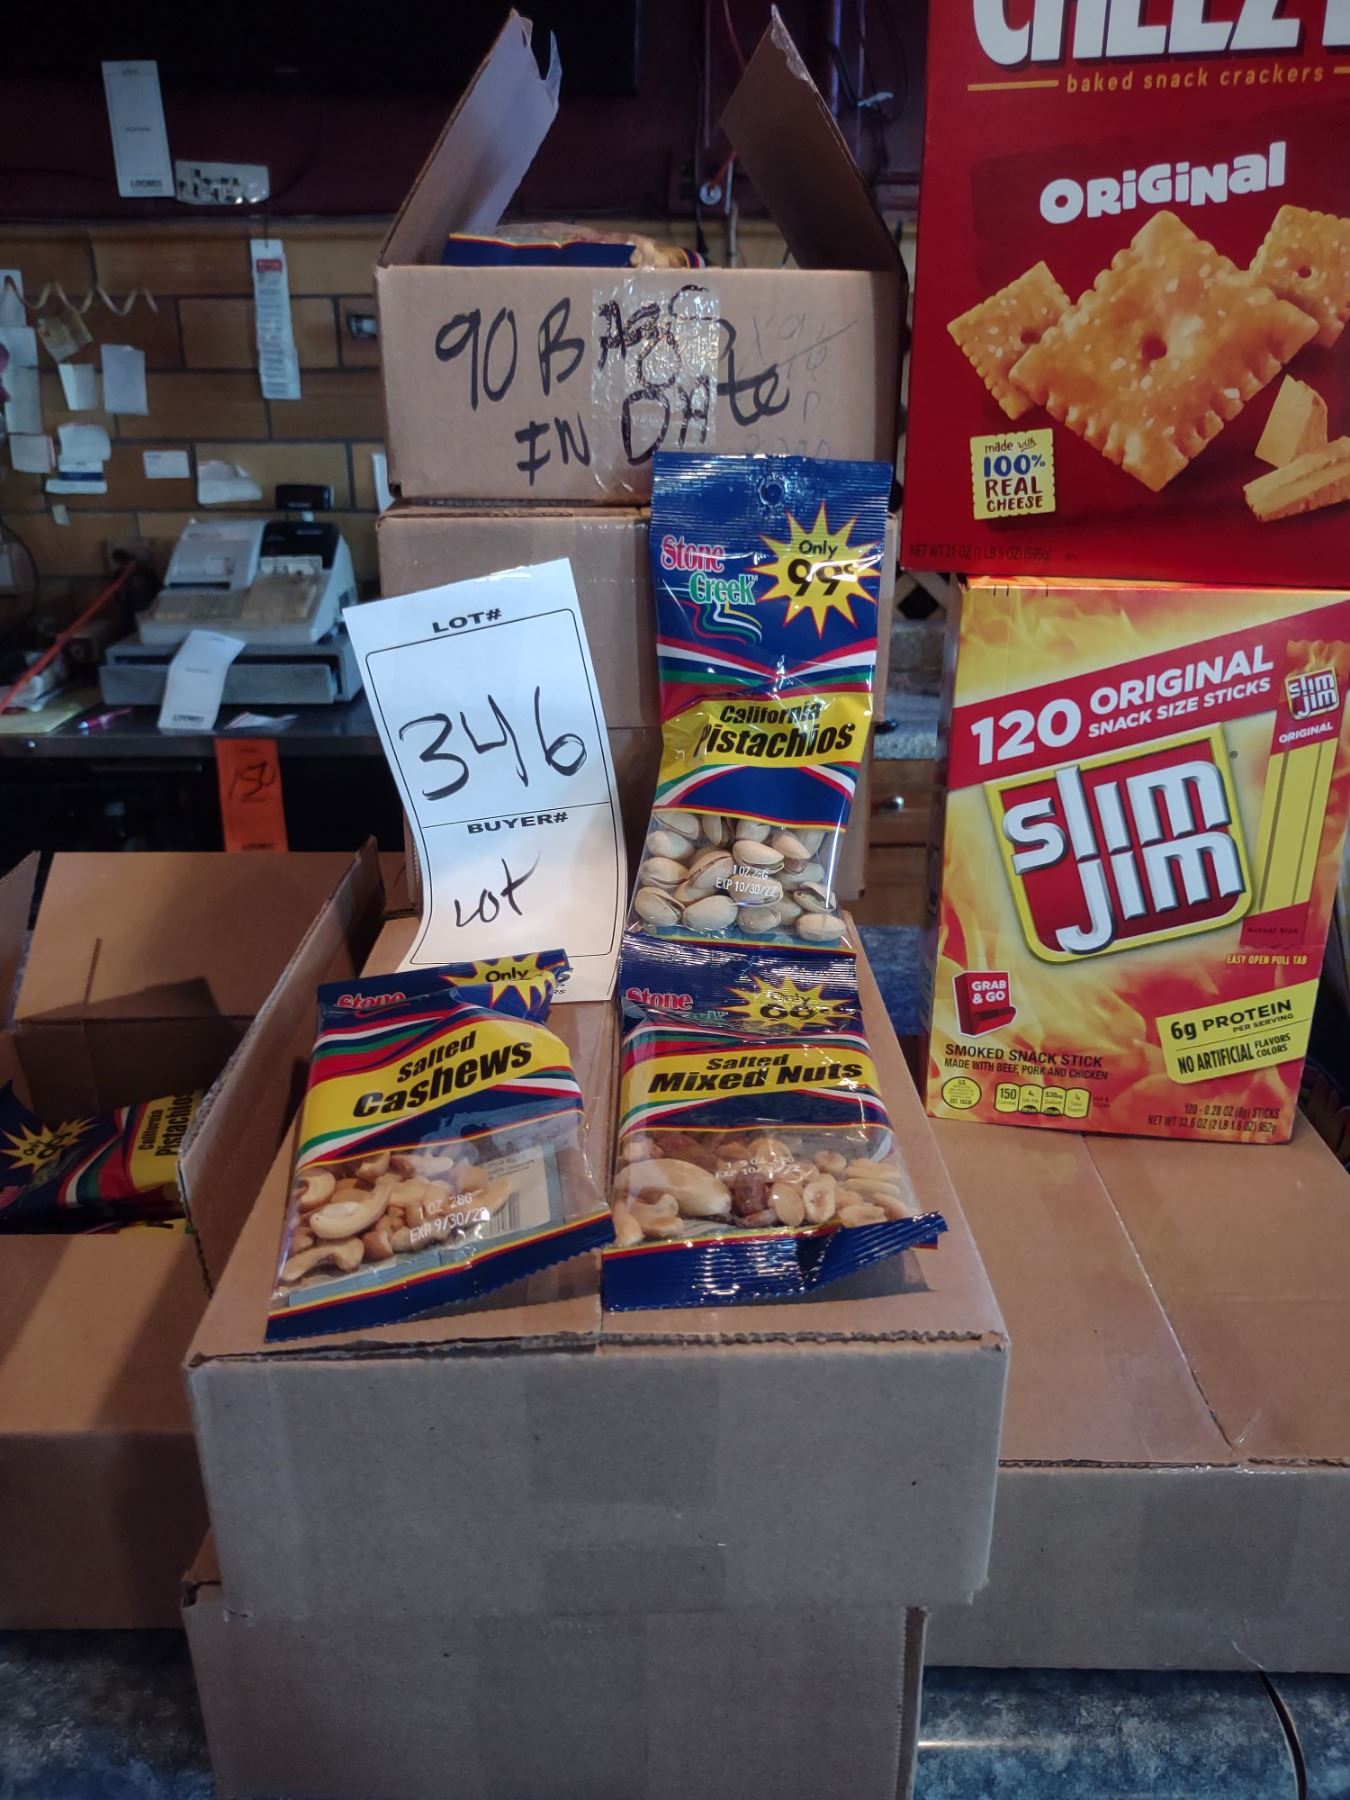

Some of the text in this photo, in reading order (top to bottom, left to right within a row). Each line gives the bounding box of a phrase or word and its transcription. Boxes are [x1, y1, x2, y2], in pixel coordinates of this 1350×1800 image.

[1066, 62, 1324, 93] baked snack crackers
[435, 307, 518, 412] 90
[515, 411, 591, 486] IN
[984, 437, 1038, 454] made with
[983, 453, 1046, 478] 100%
[984, 475, 1043, 499] REAL
[986, 495, 1043, 513] CHEESE
[661, 535, 725, 572] Stone
[798, 540, 838, 560] Only
[689, 571, 756, 606] Creek
[432, 608, 503, 634] LOT#
[1090, 645, 1274, 716] ORIGINAL
[719, 701, 821, 724] California
[1088, 677, 1271, 738] SNACK SIZE STICKS
[399, 686, 588, 801] 346
[970, 698, 1082, 766] 120
[1279, 722, 1333, 743] ORIGINAL
[468, 811, 569, 834] BUYER#
[715, 877, 733, 890] EXP
[1226, 954, 1308, 965] EASY OPEN PULL TAB
[485, 967, 529, 983] Only
[971, 979, 1006, 991] GRAB
[625, 987, 693, 1011] Stone
[972, 990, 1006, 1005] & GO
[1170, 999, 1292, 1041] 6g PROTEIN
[1232, 1012, 1294, 1033] PER SERVING
[1254, 1033, 1291, 1049] FLAVORS
[1256, 1044, 1288, 1058] COLORS
[397, 1030, 477, 1083] Salted
[706, 1054, 789, 1071] Salted
[945, 1043, 1103, 1068] SMOKED SNACK STICK
[1177, 1042, 1254, 1075] NO ARTIFICIAL
[352, 1041, 533, 1118] Cashews
[648, 1063, 863, 1094] Mixed Nuts
[944, 1057, 970, 1069] MADE
[972, 1060, 995, 1072] WITH
[1022, 1064, 1045, 1076] PORK
[1047, 1067, 1066, 1077] AND
[1068, 1068, 1109, 1081] CHICKEN
[999, 1088, 1017, 1100] 150
[410, 1222, 432, 1244] EXP
